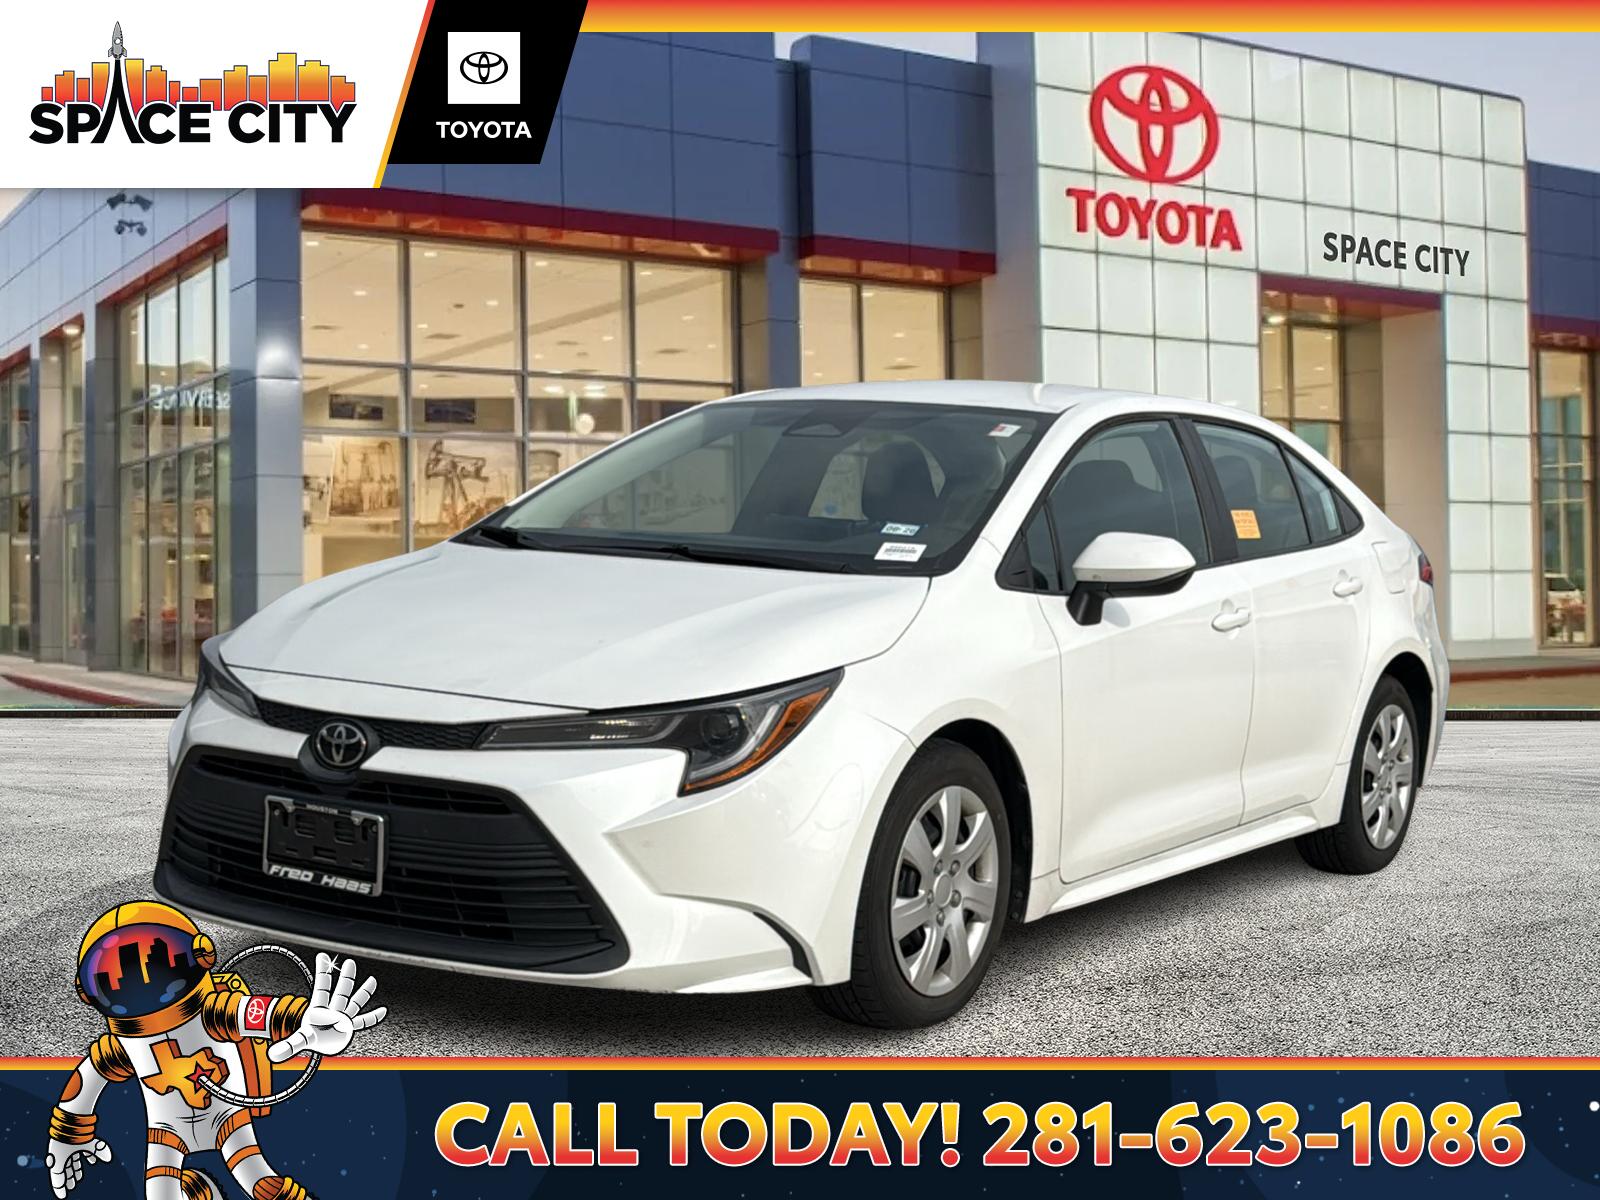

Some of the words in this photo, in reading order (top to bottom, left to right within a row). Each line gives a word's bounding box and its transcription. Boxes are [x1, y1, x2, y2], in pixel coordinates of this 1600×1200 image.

[1066, 187, 1242, 252] TOYOTA
[1323, 232, 1407, 270] SPACE
[1414, 244, 1471, 277] CITY
